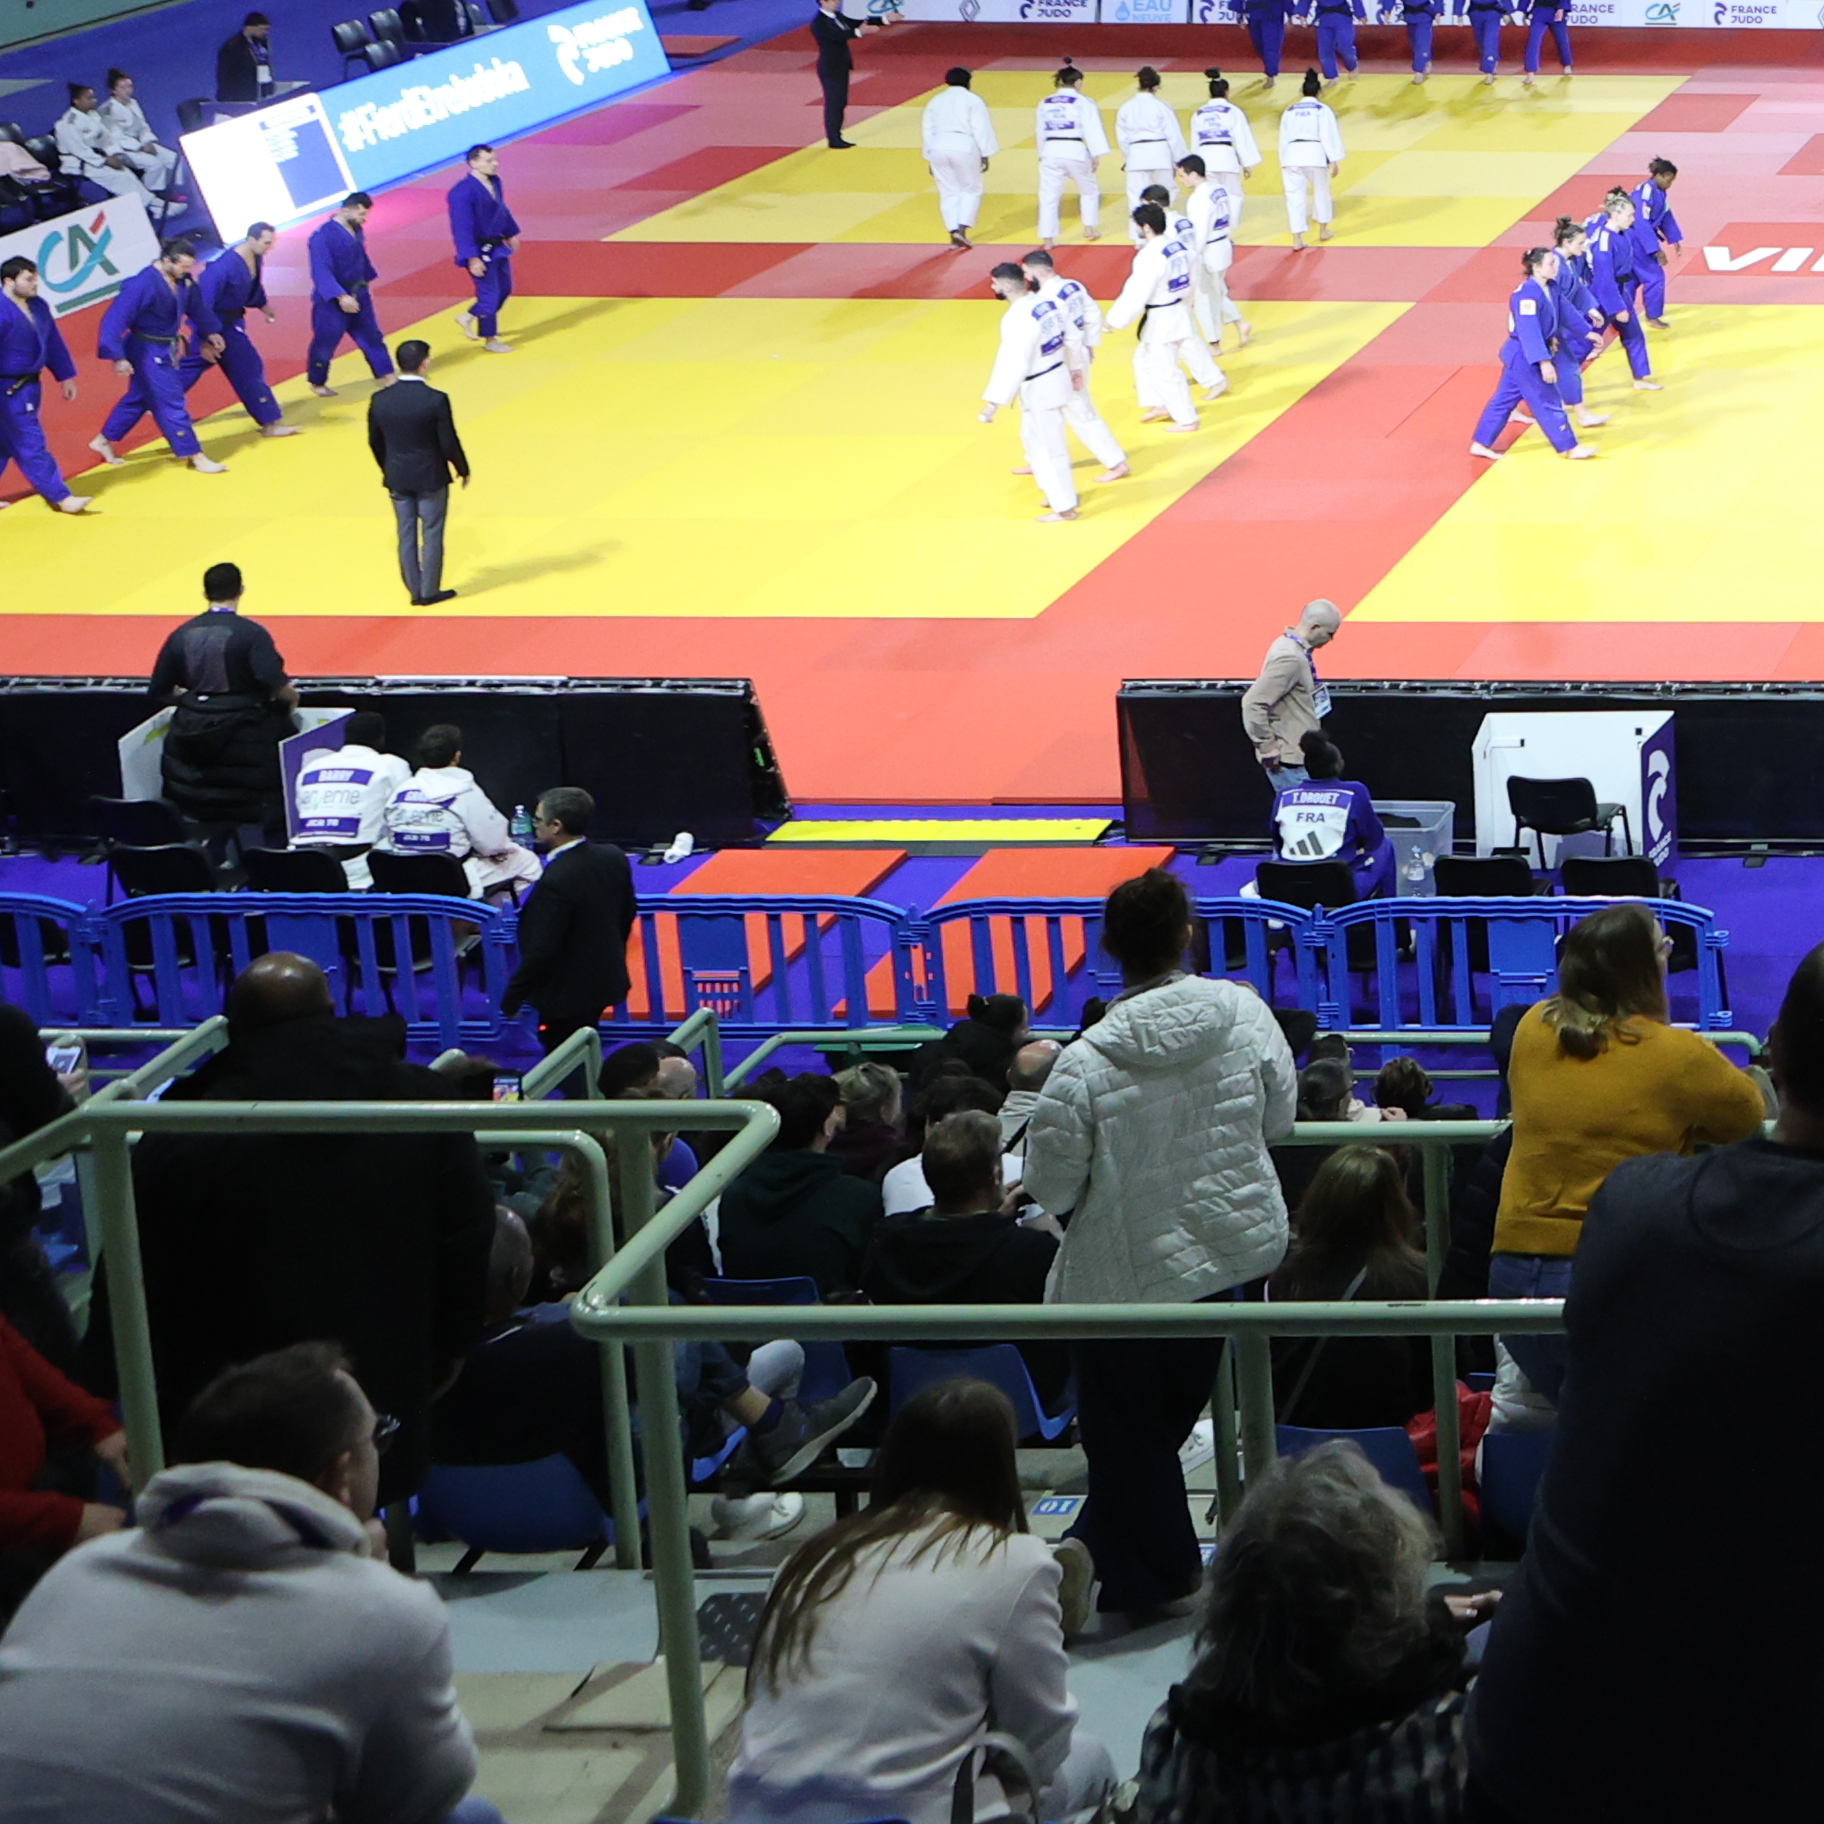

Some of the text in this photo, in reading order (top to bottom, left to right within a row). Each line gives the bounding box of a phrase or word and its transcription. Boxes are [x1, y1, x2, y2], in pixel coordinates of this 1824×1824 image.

[1037, 8, 1072, 20] JUDO
[1570, 3, 1616, 15] RANCE
[1730, 4, 1779, 15] FRANCE
[1730, 14, 1764, 25] JUDO
[1296, 812, 1326, 823] FRA
